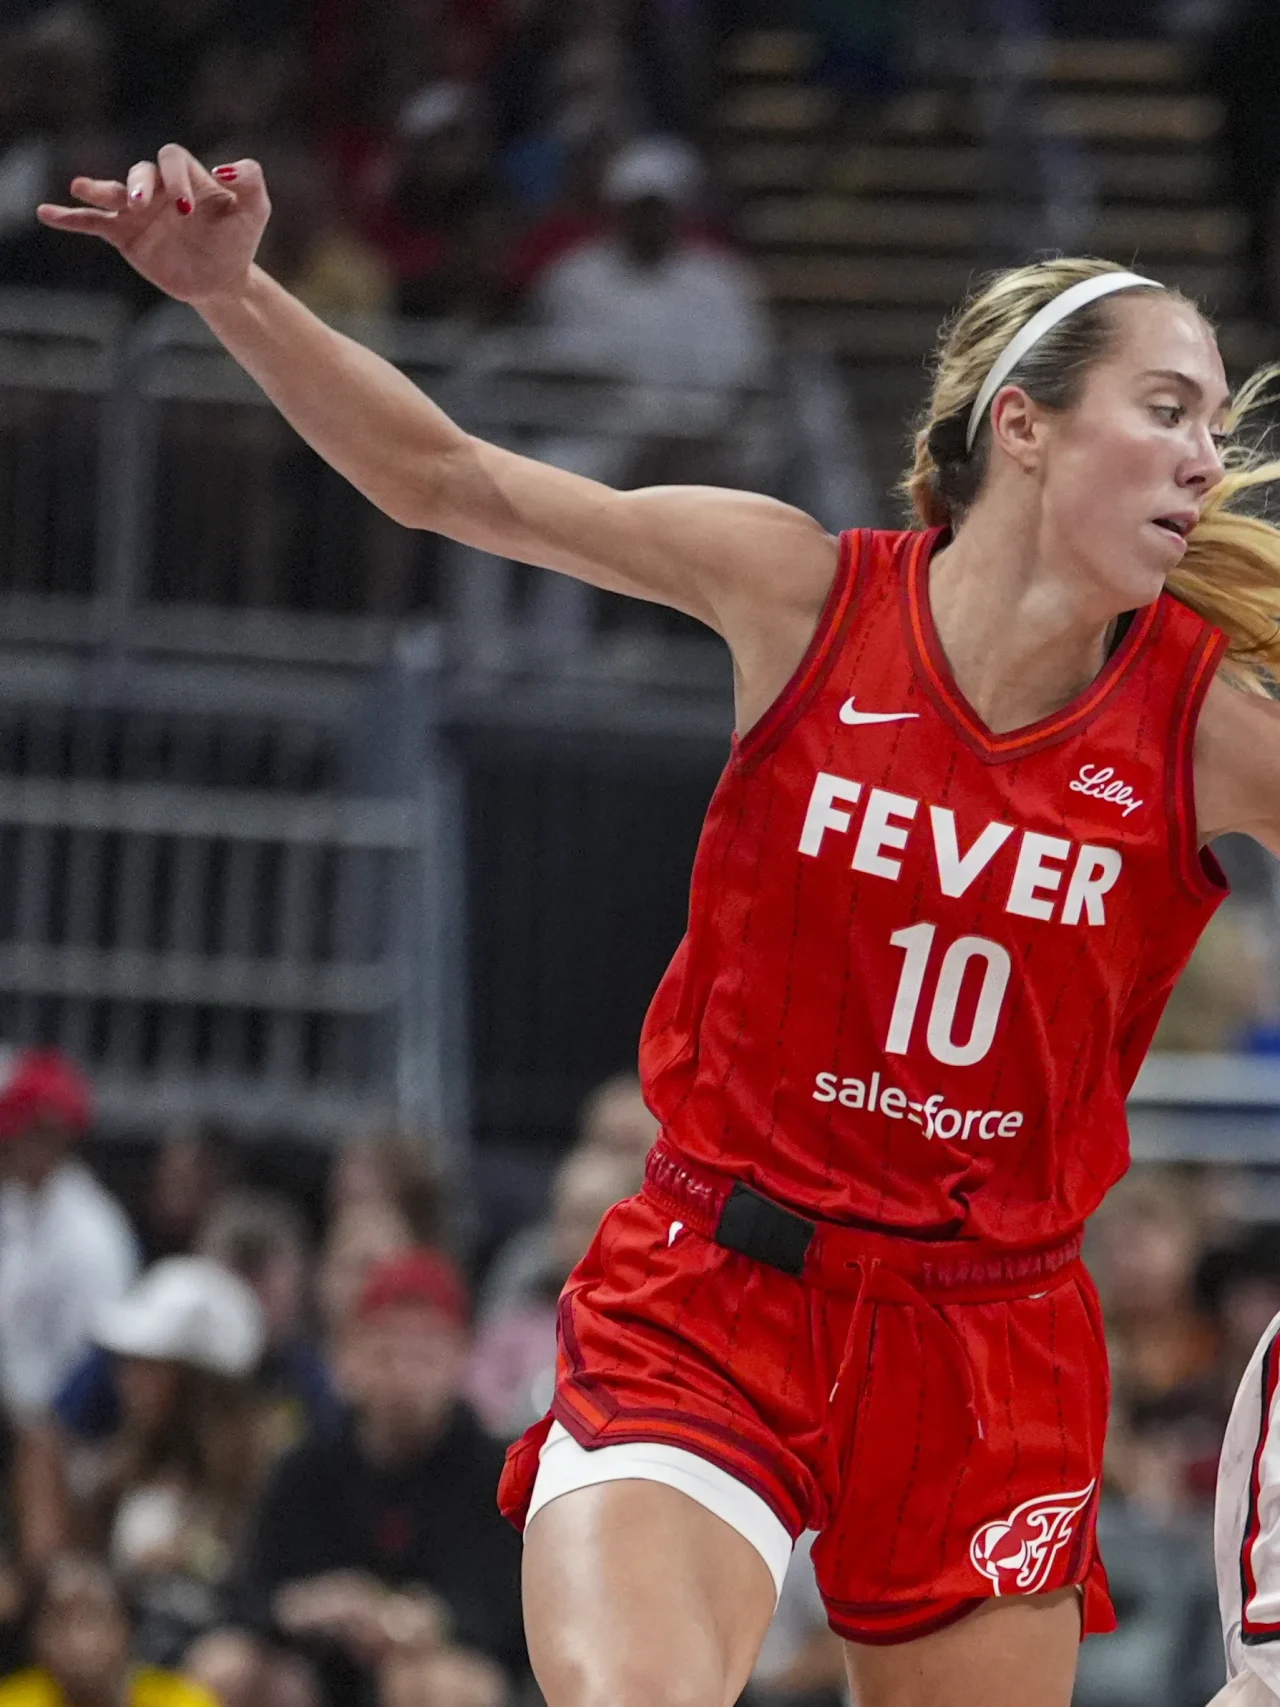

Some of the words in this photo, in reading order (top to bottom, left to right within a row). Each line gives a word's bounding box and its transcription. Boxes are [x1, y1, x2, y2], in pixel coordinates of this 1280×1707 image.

[797, 771, 1123, 927] FEVER
[1069, 763, 1143, 817] Lilly
[884, 920, 1012, 1067] 10
